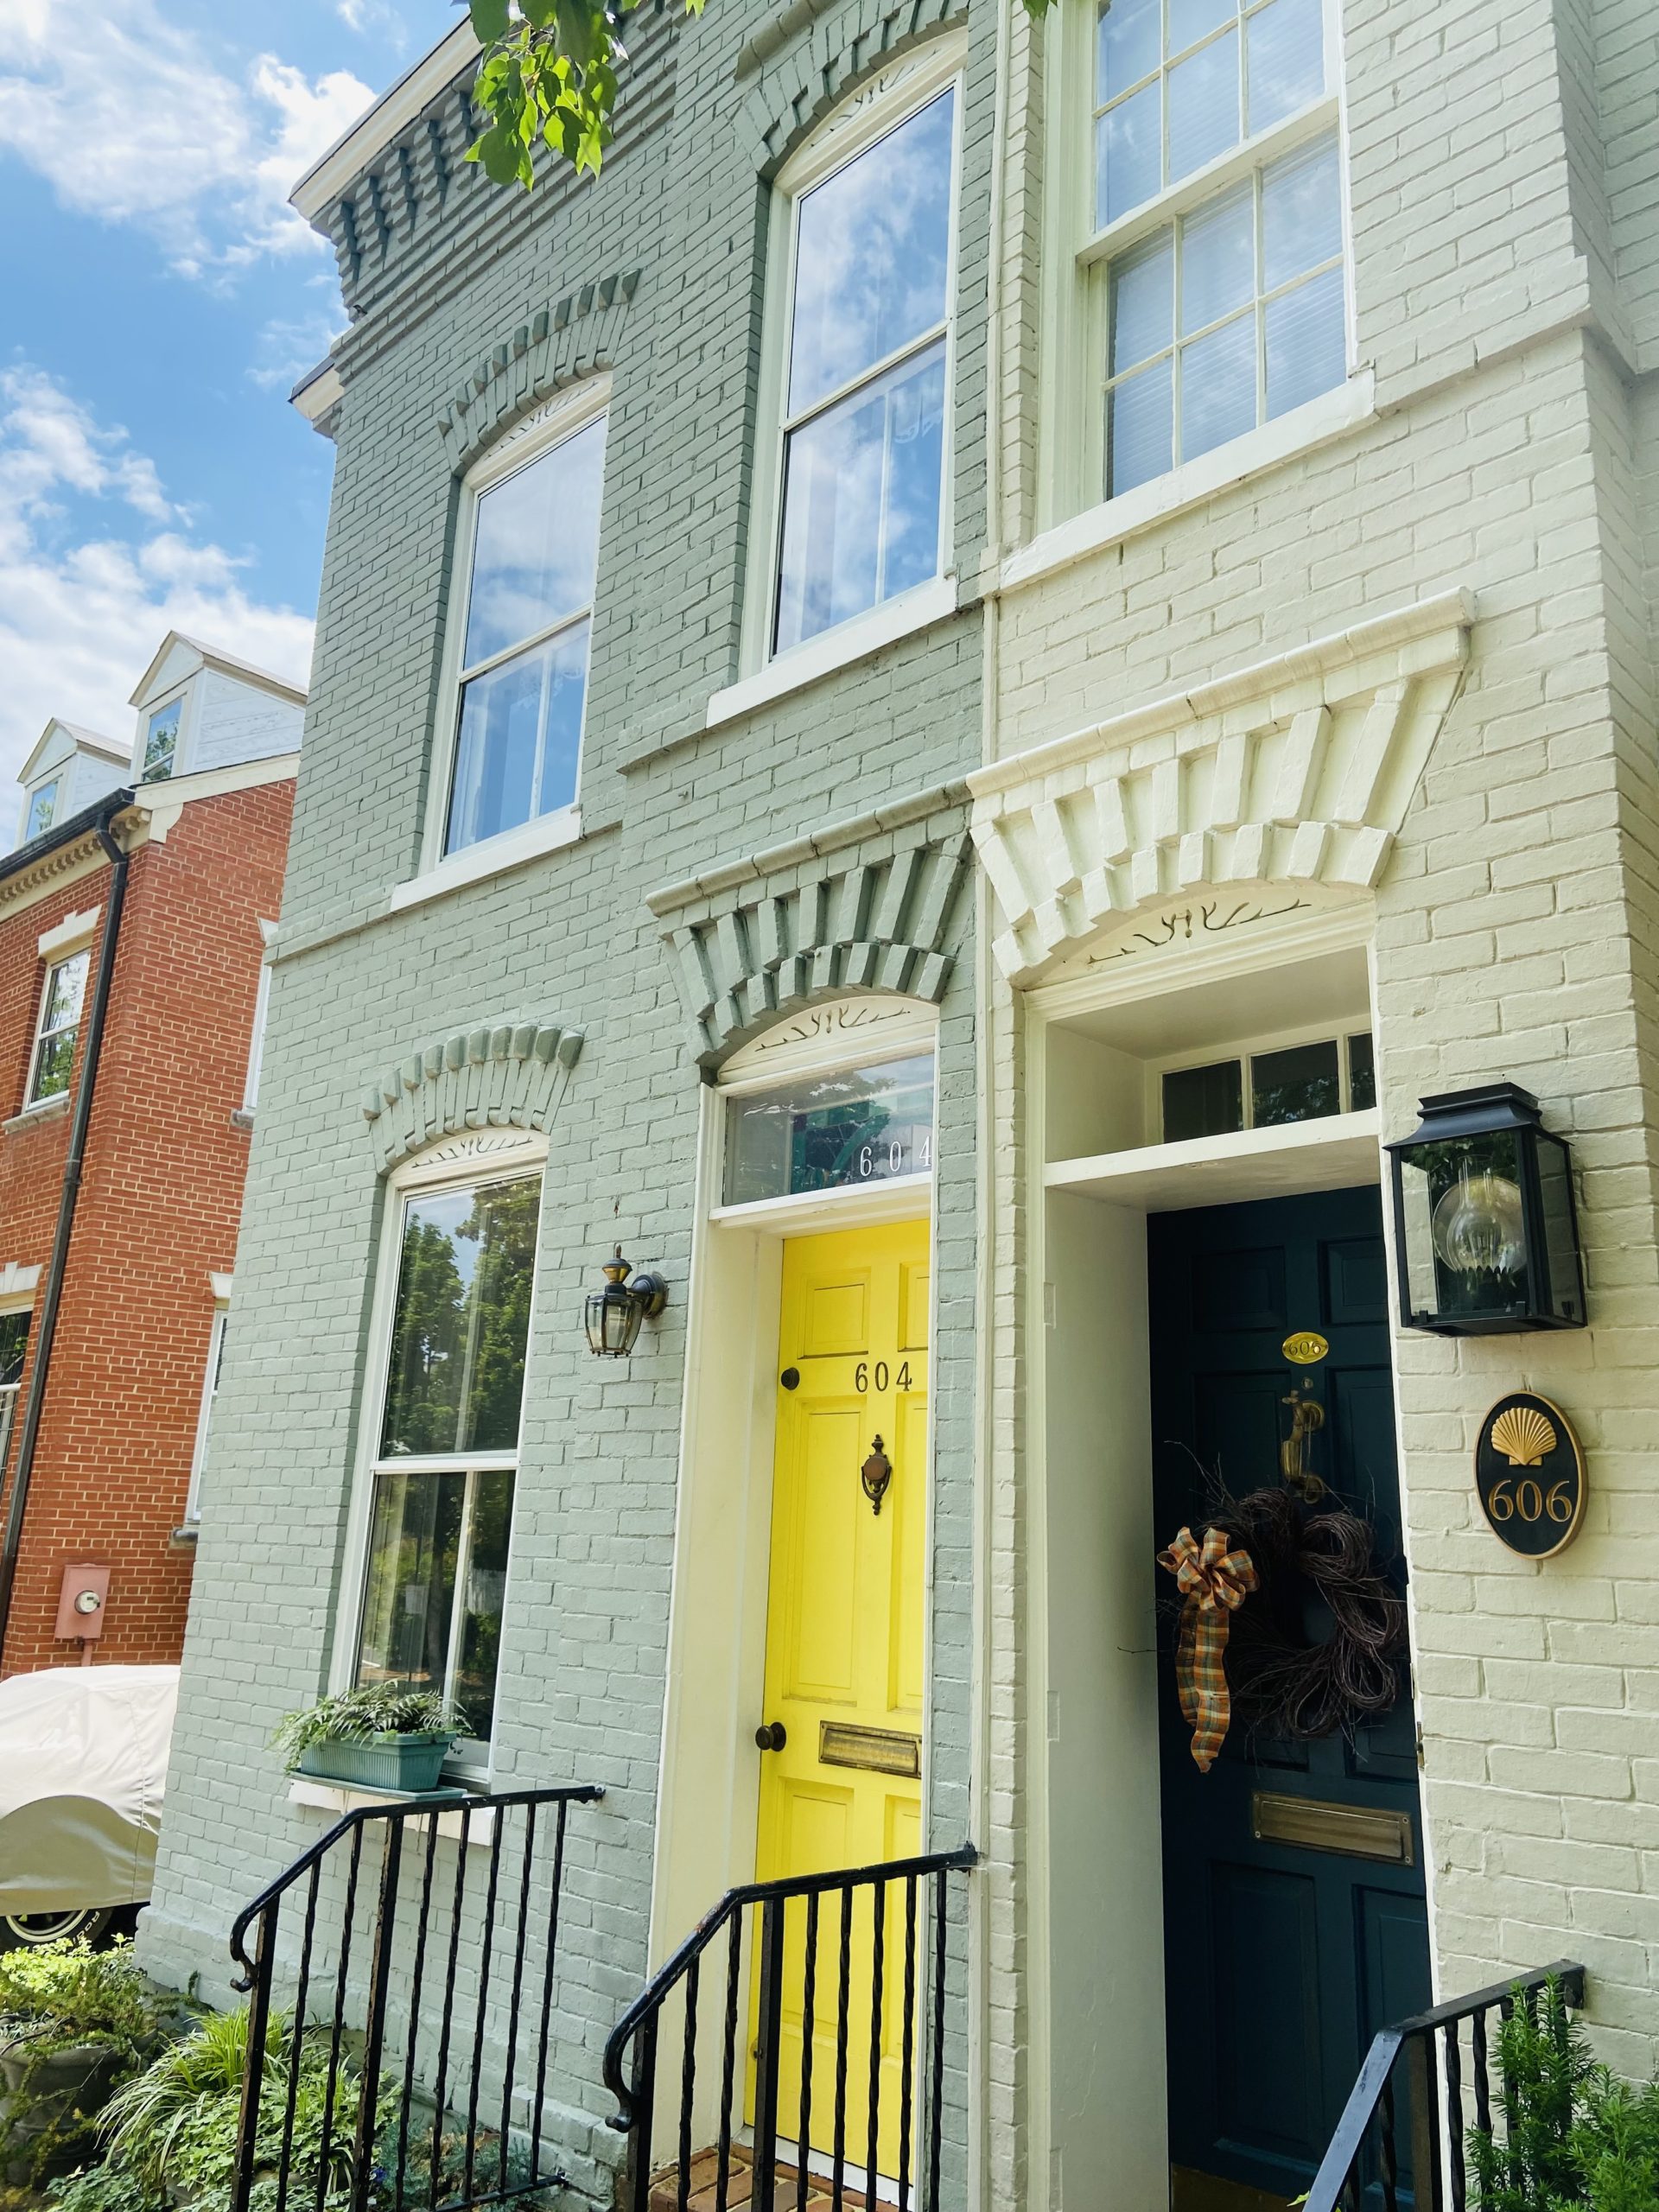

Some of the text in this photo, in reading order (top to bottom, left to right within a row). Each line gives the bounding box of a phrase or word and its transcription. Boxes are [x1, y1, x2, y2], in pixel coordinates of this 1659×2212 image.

[860, 1135, 932, 1177] 604
[1288, 1340, 1322, 1357] 606
[855, 1361, 912, 1393] 604
[1488, 1478, 1573, 1522] 606
